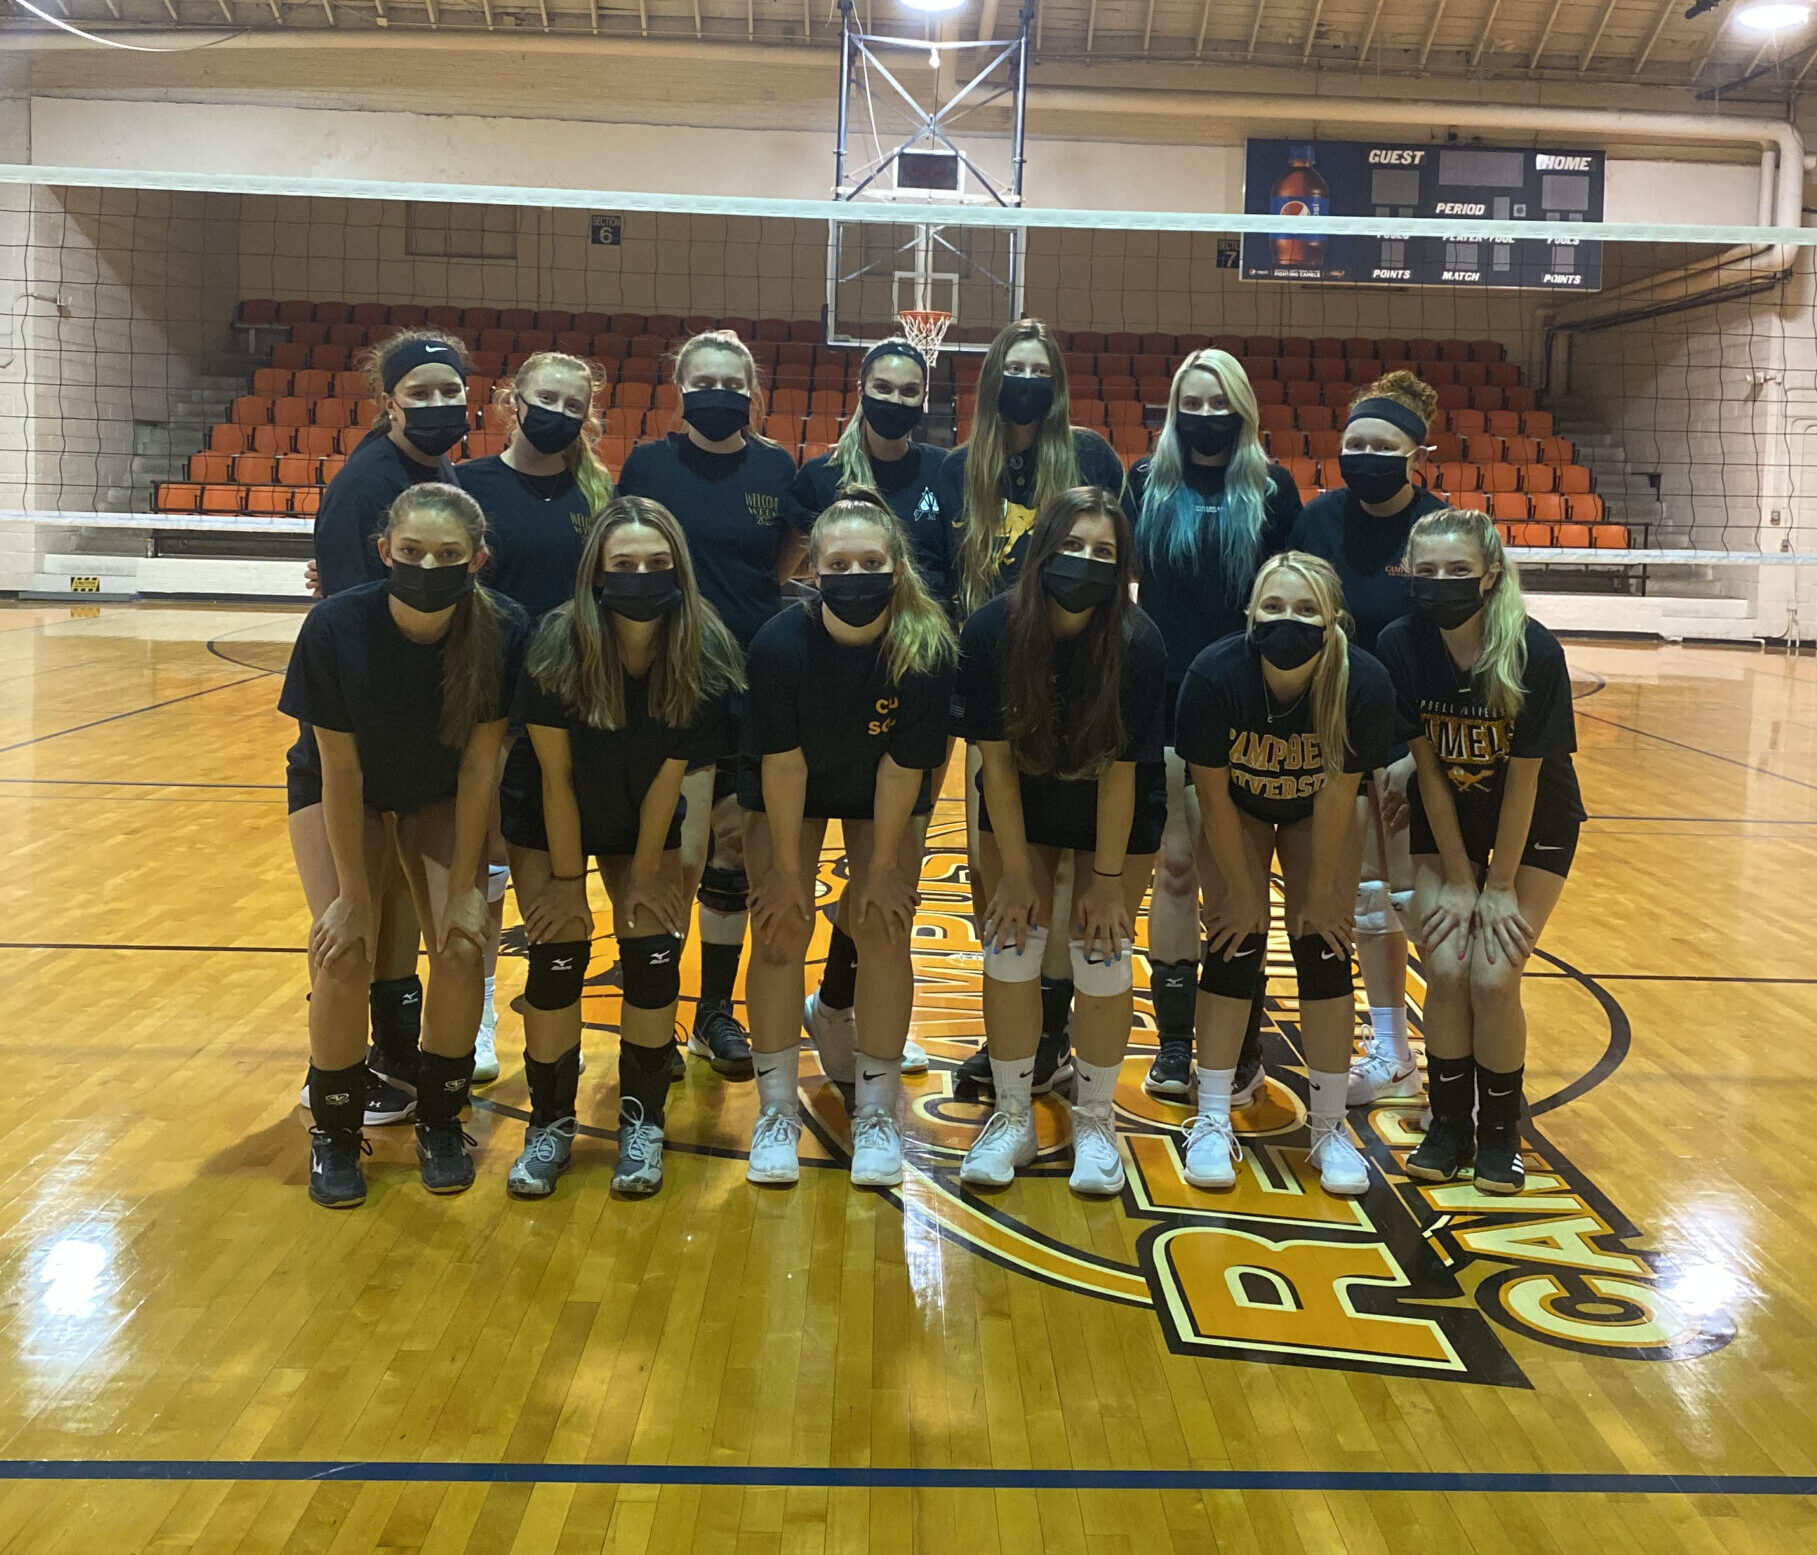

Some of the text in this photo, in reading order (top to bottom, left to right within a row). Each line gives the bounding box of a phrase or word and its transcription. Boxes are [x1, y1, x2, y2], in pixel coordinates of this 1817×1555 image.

[1368, 149, 1425, 165] GUEST
[1542, 155, 1592, 171] HOME
[1435, 202, 1486, 216] PERIOD
[600, 227, 612, 244] 6
[1224, 251, 1238, 267] 7
[1373, 269, 1411, 279] POINTS
[1442, 271, 1480, 281] MATCH
[1543, 274, 1581, 284] POINTS
